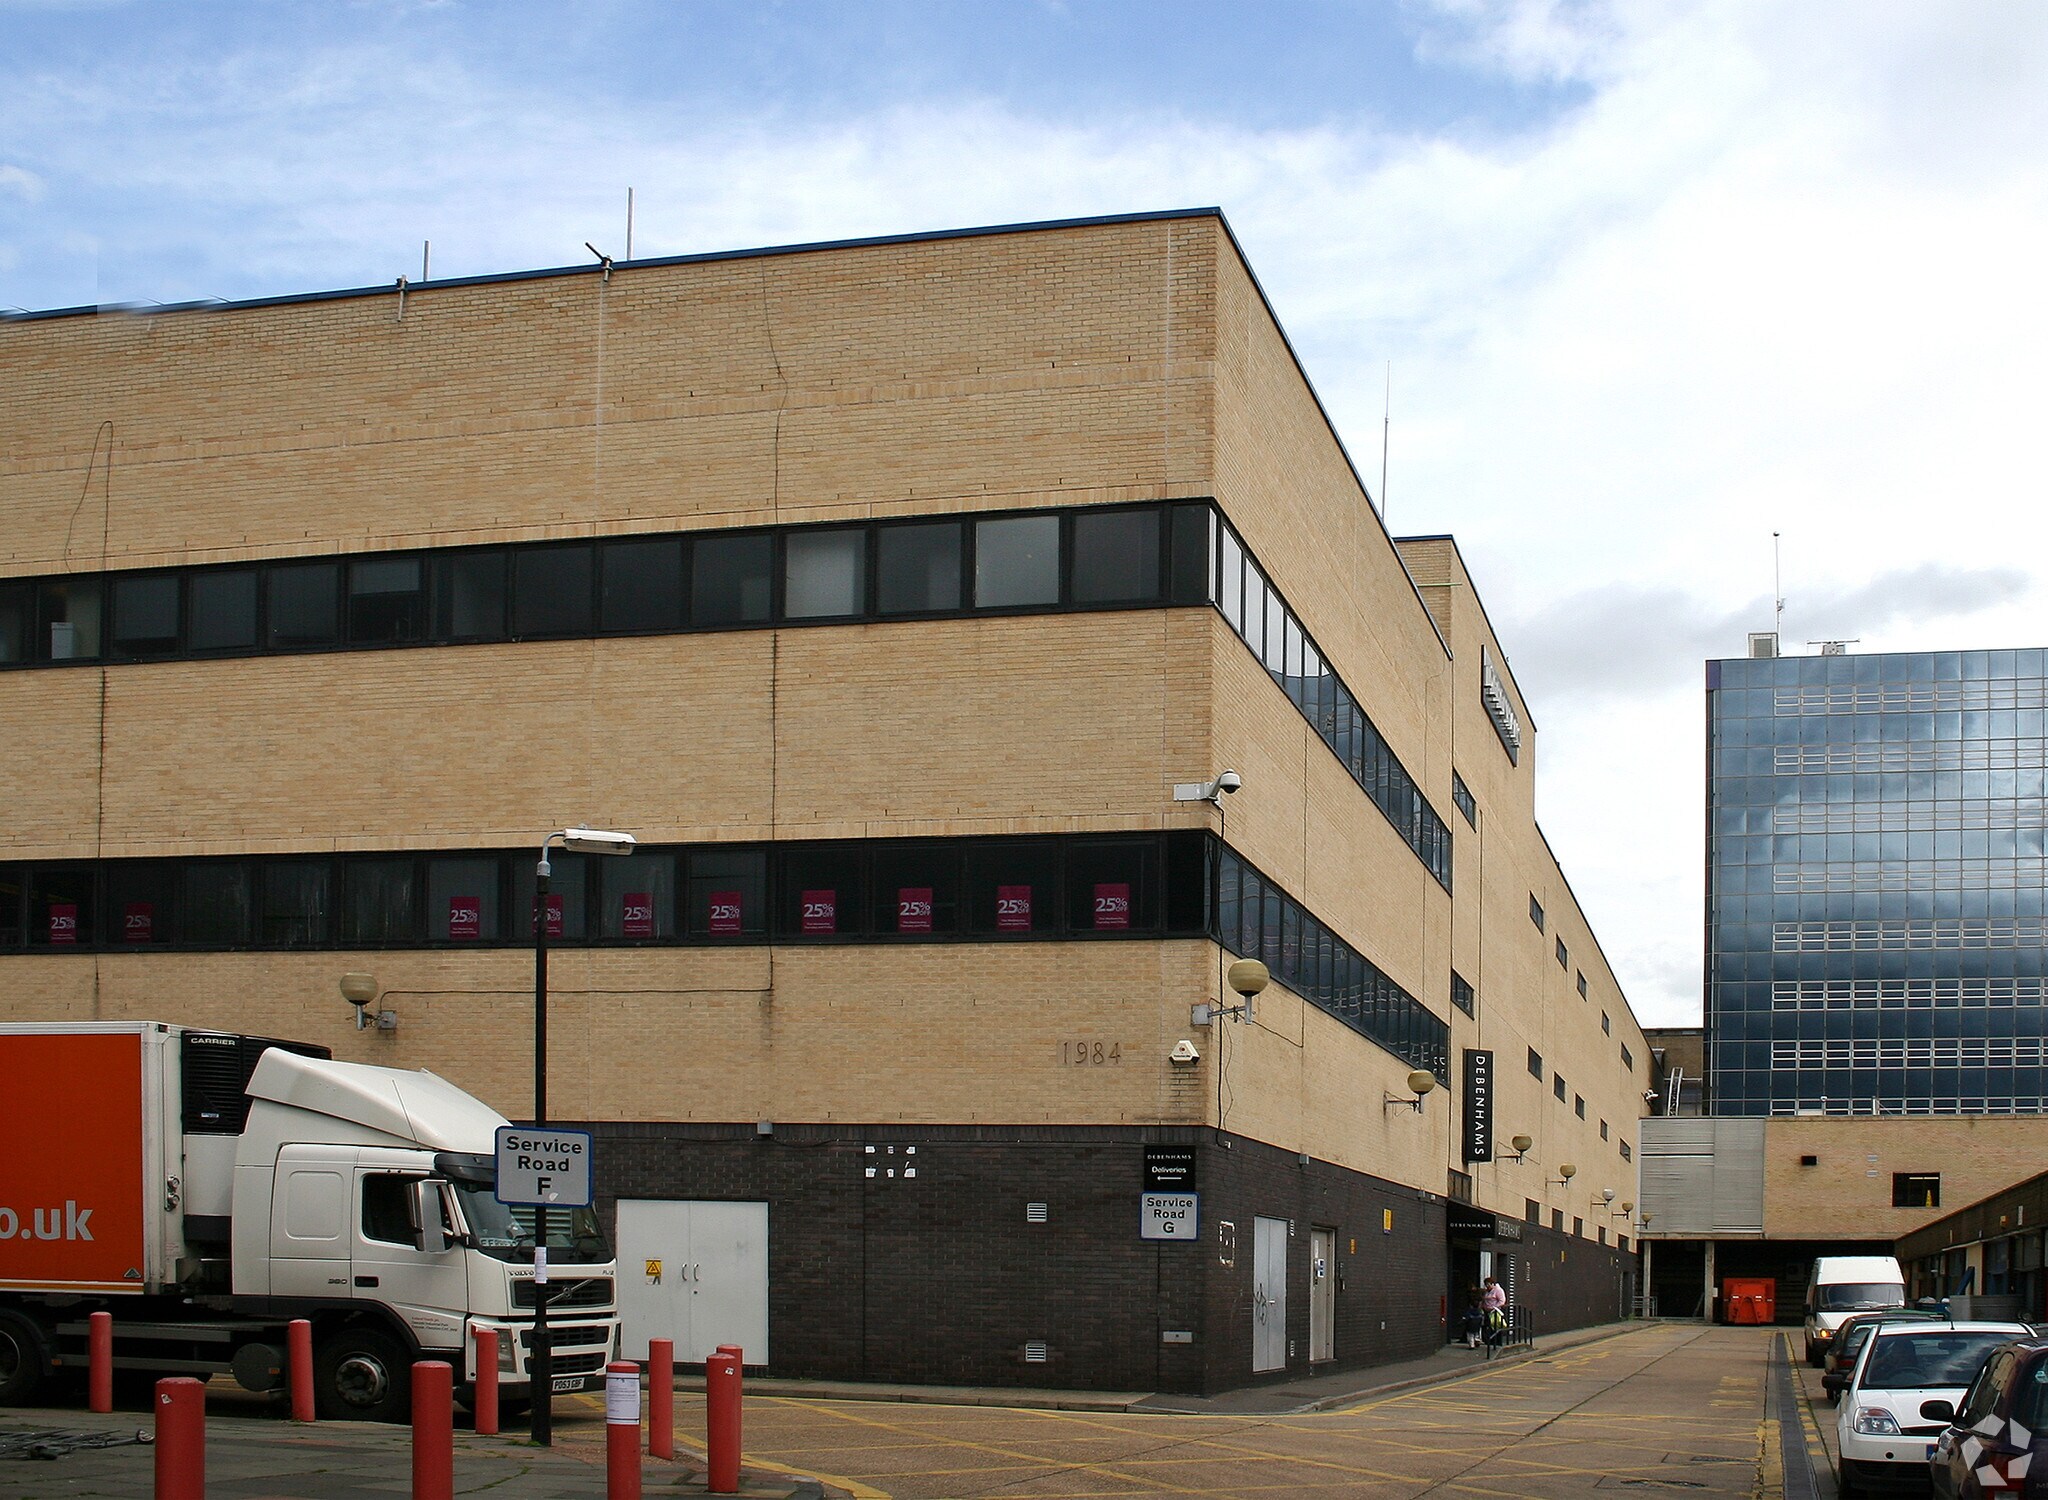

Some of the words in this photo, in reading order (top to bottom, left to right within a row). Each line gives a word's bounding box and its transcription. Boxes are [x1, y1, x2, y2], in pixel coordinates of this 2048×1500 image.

[804, 903, 834, 917] 25%
[900, 901, 931, 916] 25%
[998, 899, 1029, 914] 25%
[1095, 897, 1128, 912] 25%
[451, 909, 478, 923] 25%
[624, 906, 652, 920] 25%
[711, 905, 740, 919] 25%
[190, 1037, 236, 1046] CARRIER
[1063, 1041, 1121, 1065] 1984
[1474, 1055, 1486, 1155] DEBENHAMS
[506, 1135, 582, 1154] Service
[518, 1155, 569, 1172] Road
[1151, 1165, 1187, 1174] Deliveries
[537, 1176, 552, 1195] F
[1147, 1197, 1193, 1208] Service
[1153, 1208, 1185, 1219] Road
[1162, 1221, 1175, 1234] G
